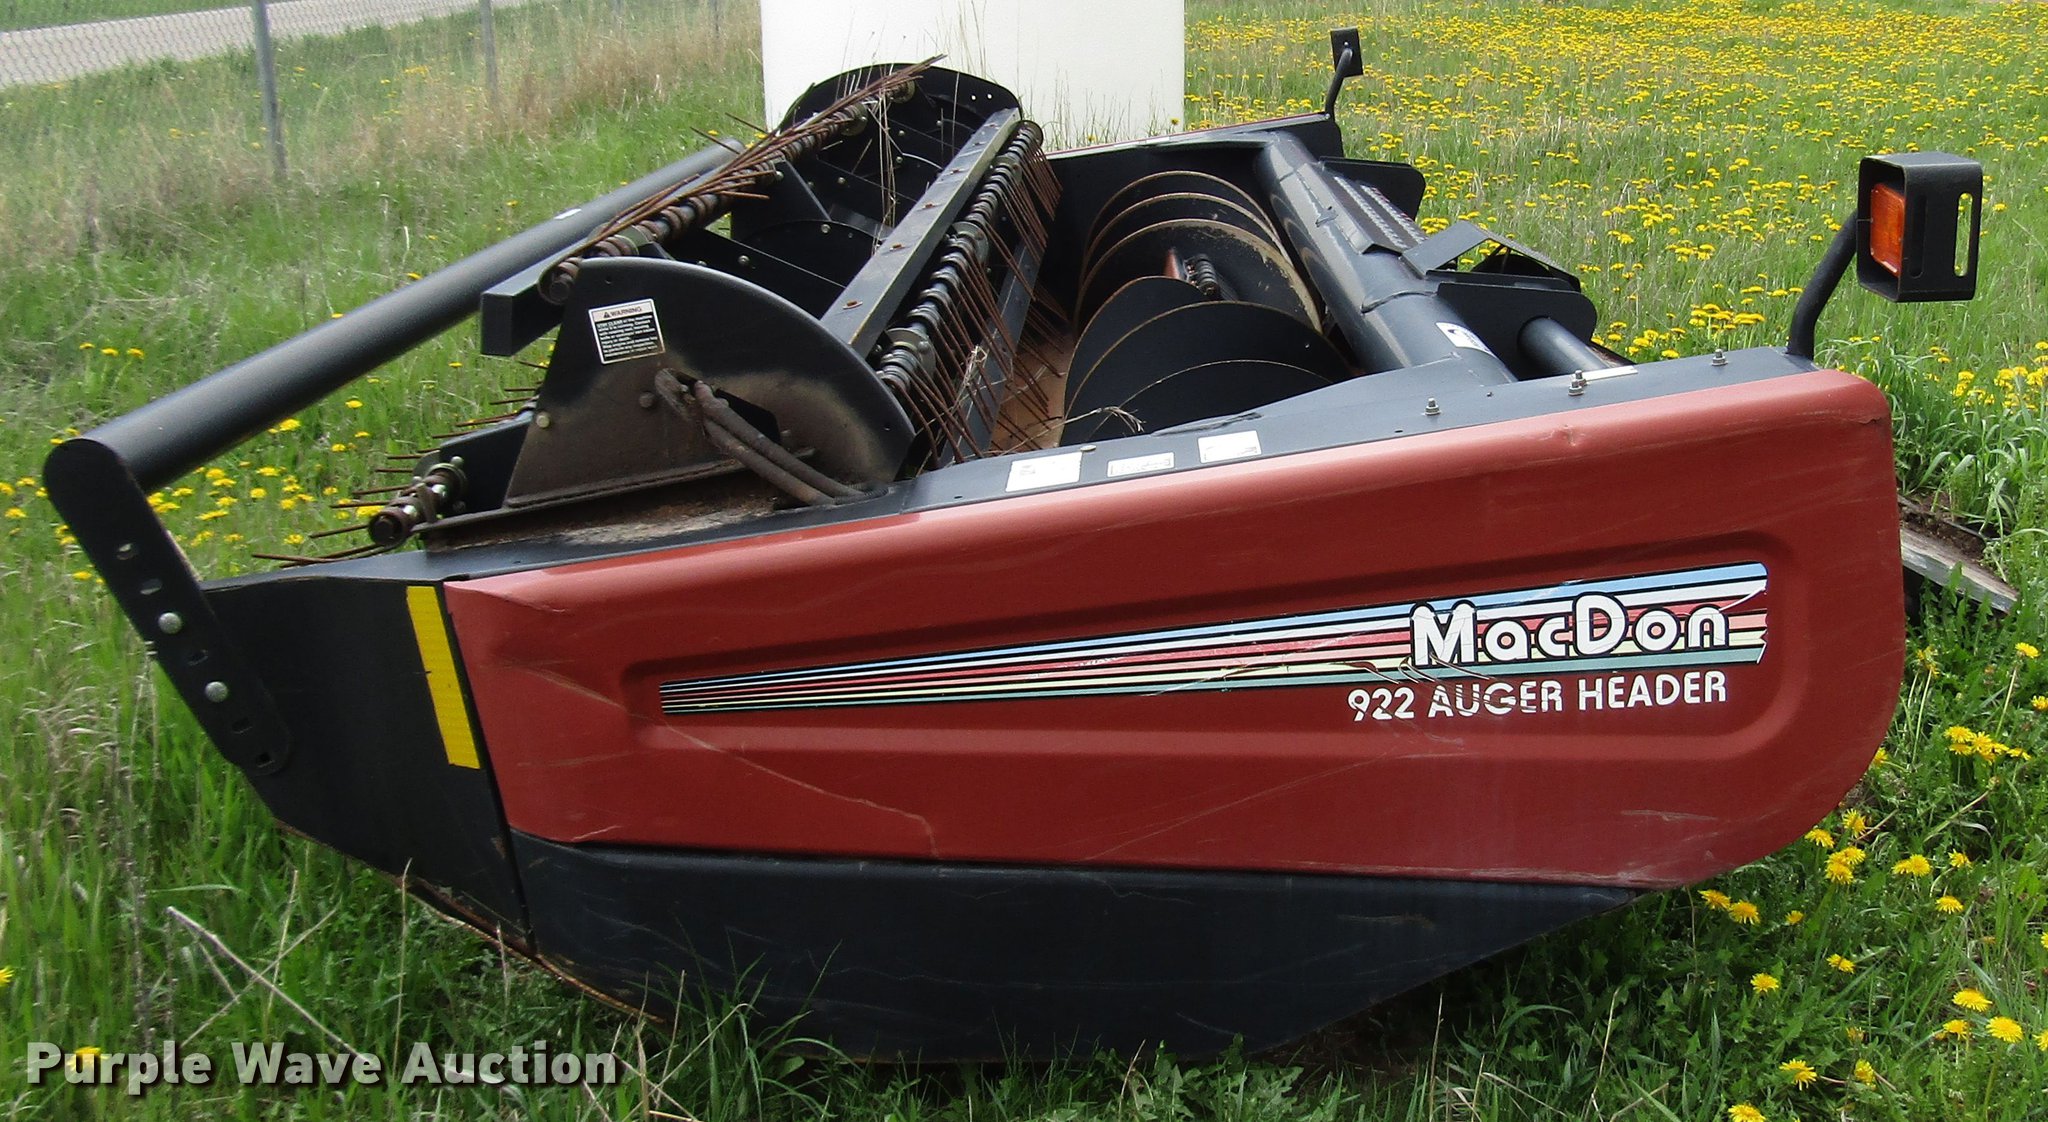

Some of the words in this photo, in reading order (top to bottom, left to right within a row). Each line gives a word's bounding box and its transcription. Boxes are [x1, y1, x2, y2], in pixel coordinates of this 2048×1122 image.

[610, 306, 643, 317] WARNING
[1410, 594, 1726, 667] MacDon
[1348, 690, 1416, 722] 922
[1427, 680, 1564, 719] AUGER
[1578, 671, 1727, 711] HEADER
